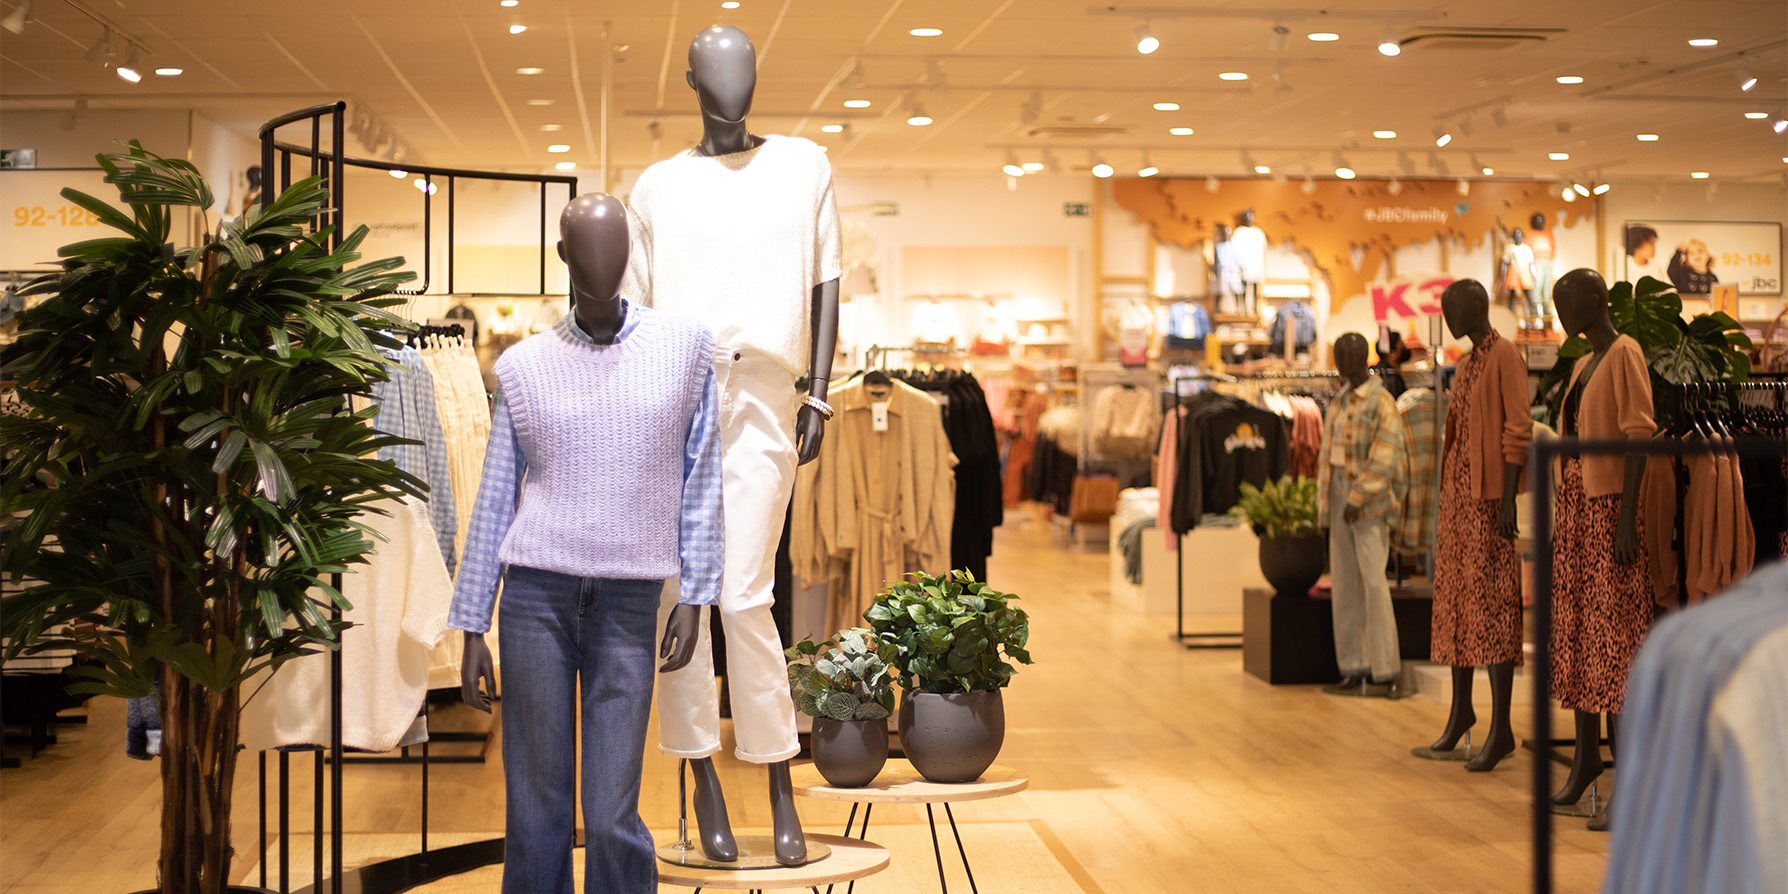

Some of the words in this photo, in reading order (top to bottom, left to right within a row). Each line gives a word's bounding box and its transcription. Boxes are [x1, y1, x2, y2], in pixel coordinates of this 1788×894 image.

[1363, 206, 1449, 226] #JBCfamily
[1721, 252, 1772, 267] 92-134
[1751, 275, 1777, 292] jbc
